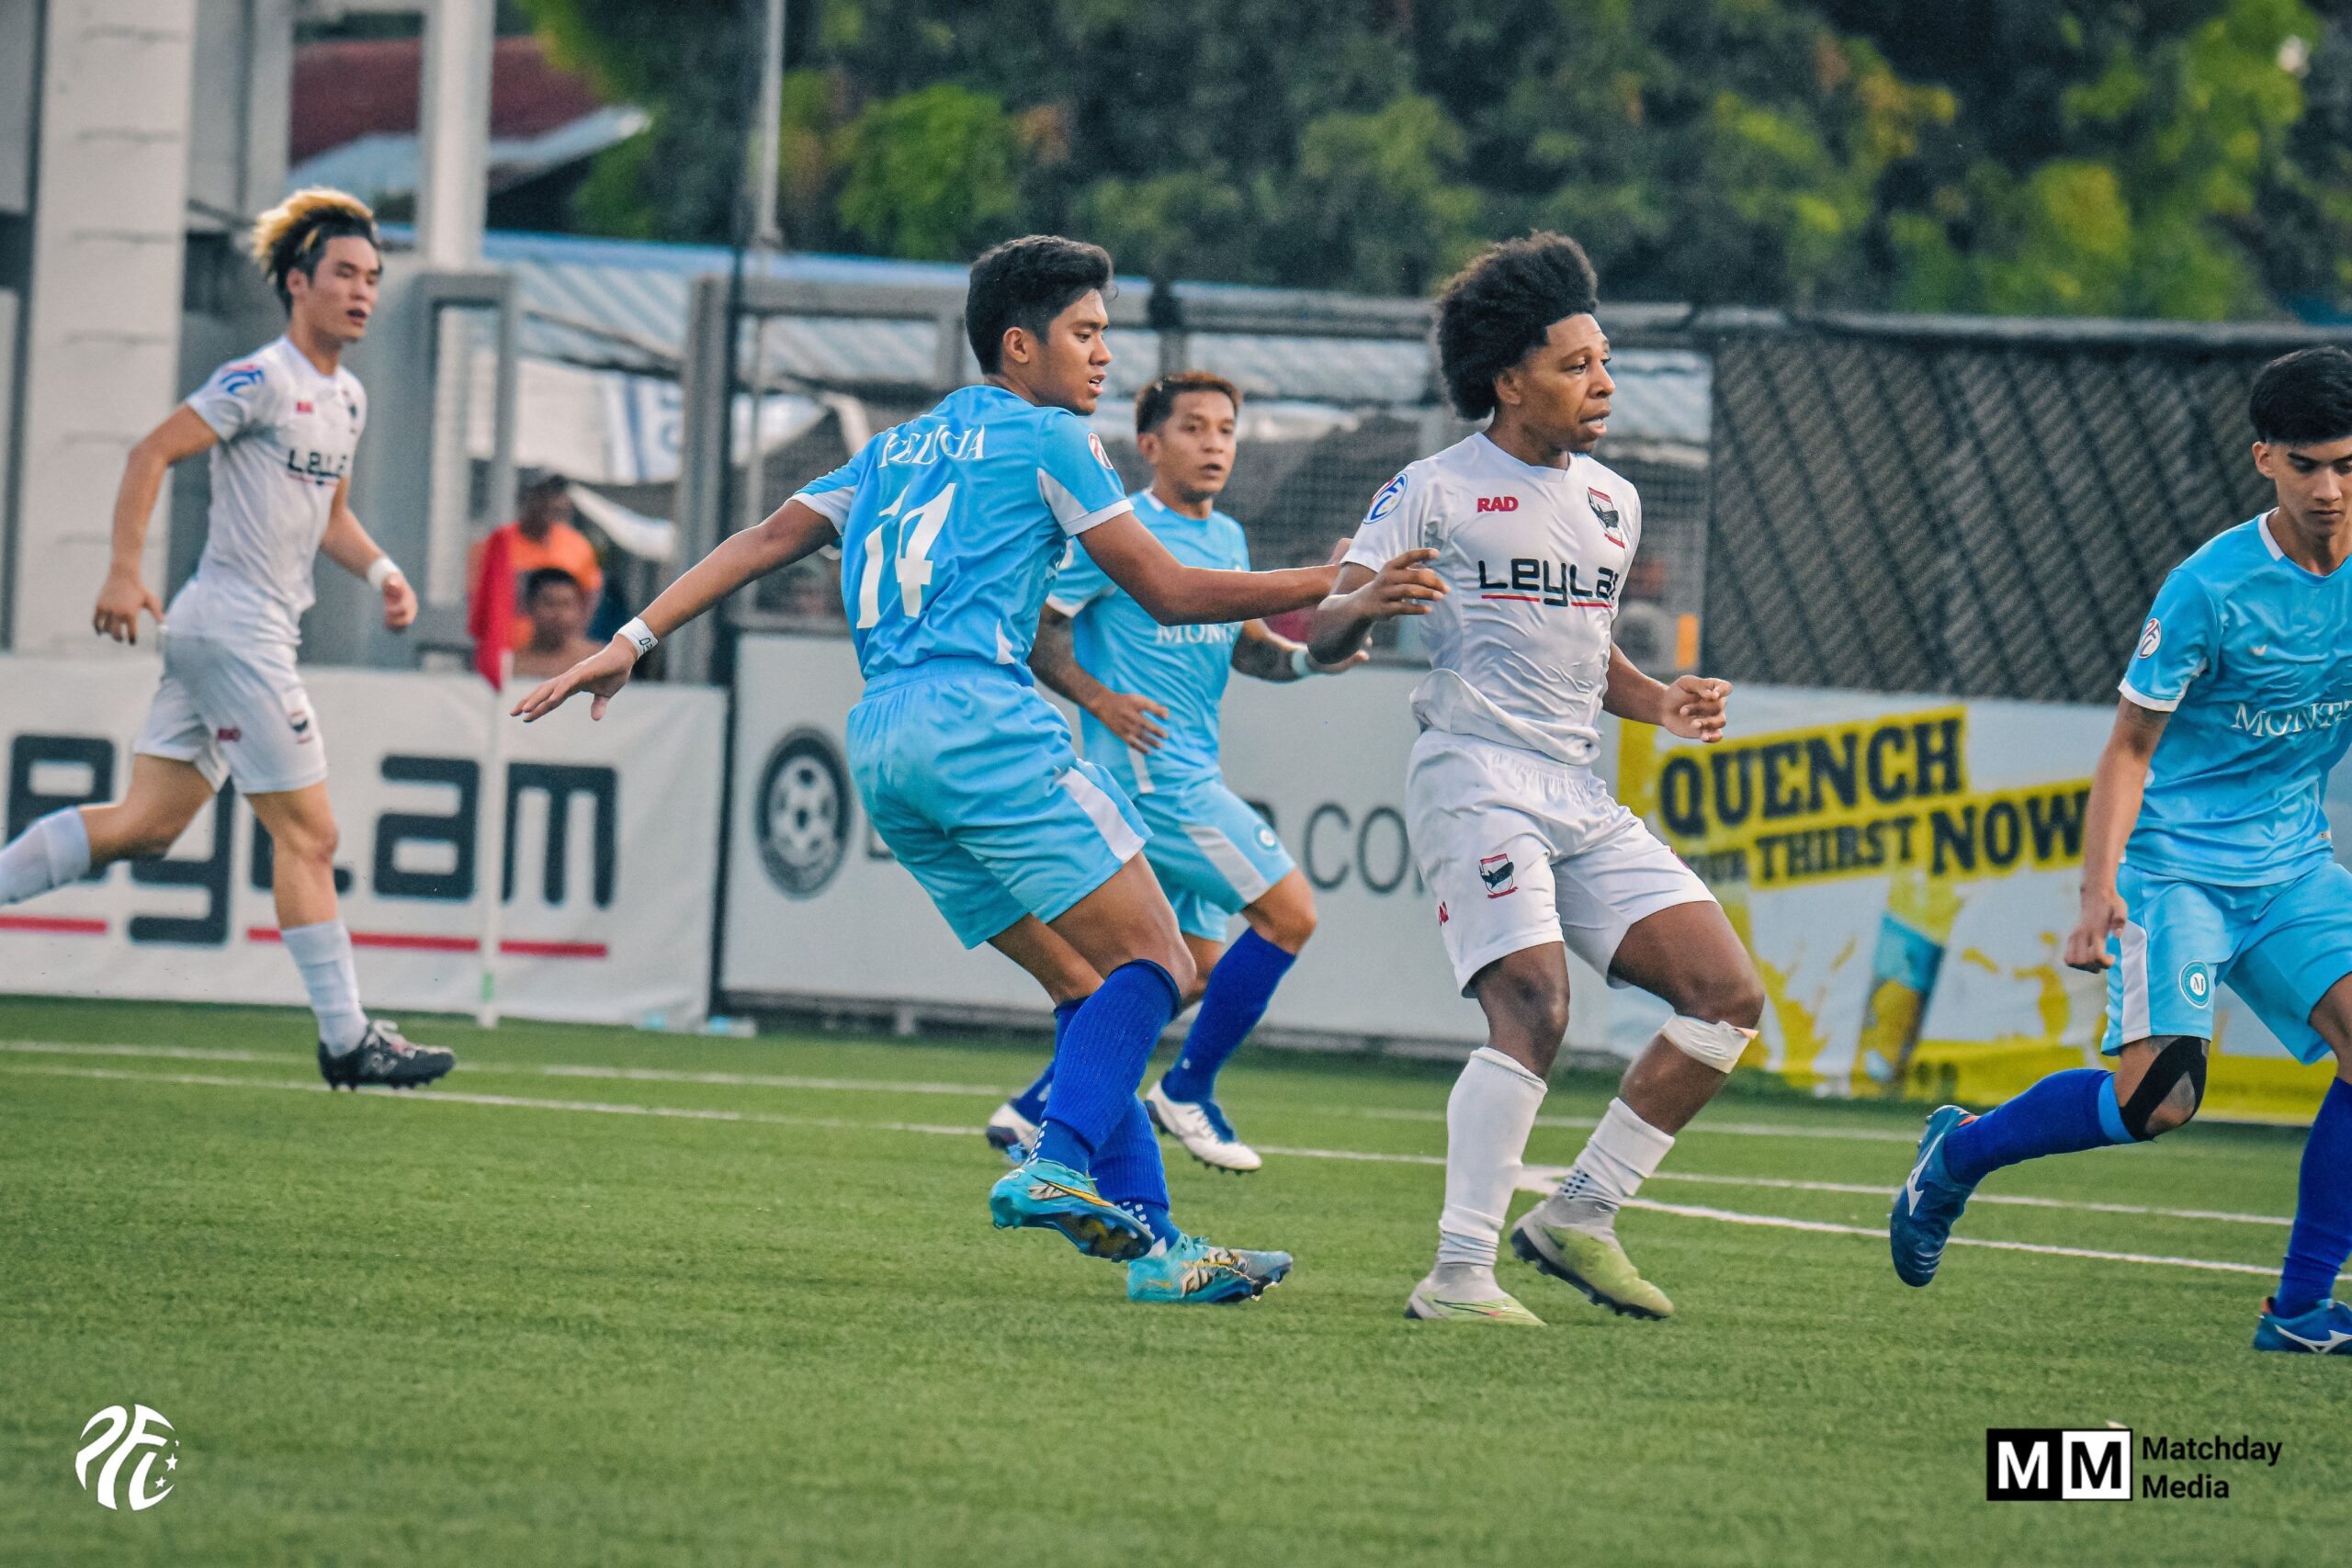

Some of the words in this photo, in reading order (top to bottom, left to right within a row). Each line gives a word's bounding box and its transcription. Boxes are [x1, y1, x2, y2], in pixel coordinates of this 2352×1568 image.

[856, 482, 956, 629] 14
[1477, 496, 1519, 513] RAD
[1659, 718, 1962, 838] QUENCH
[1756, 815, 1916, 884] THIRST
[1930, 787, 2090, 876] NOW
